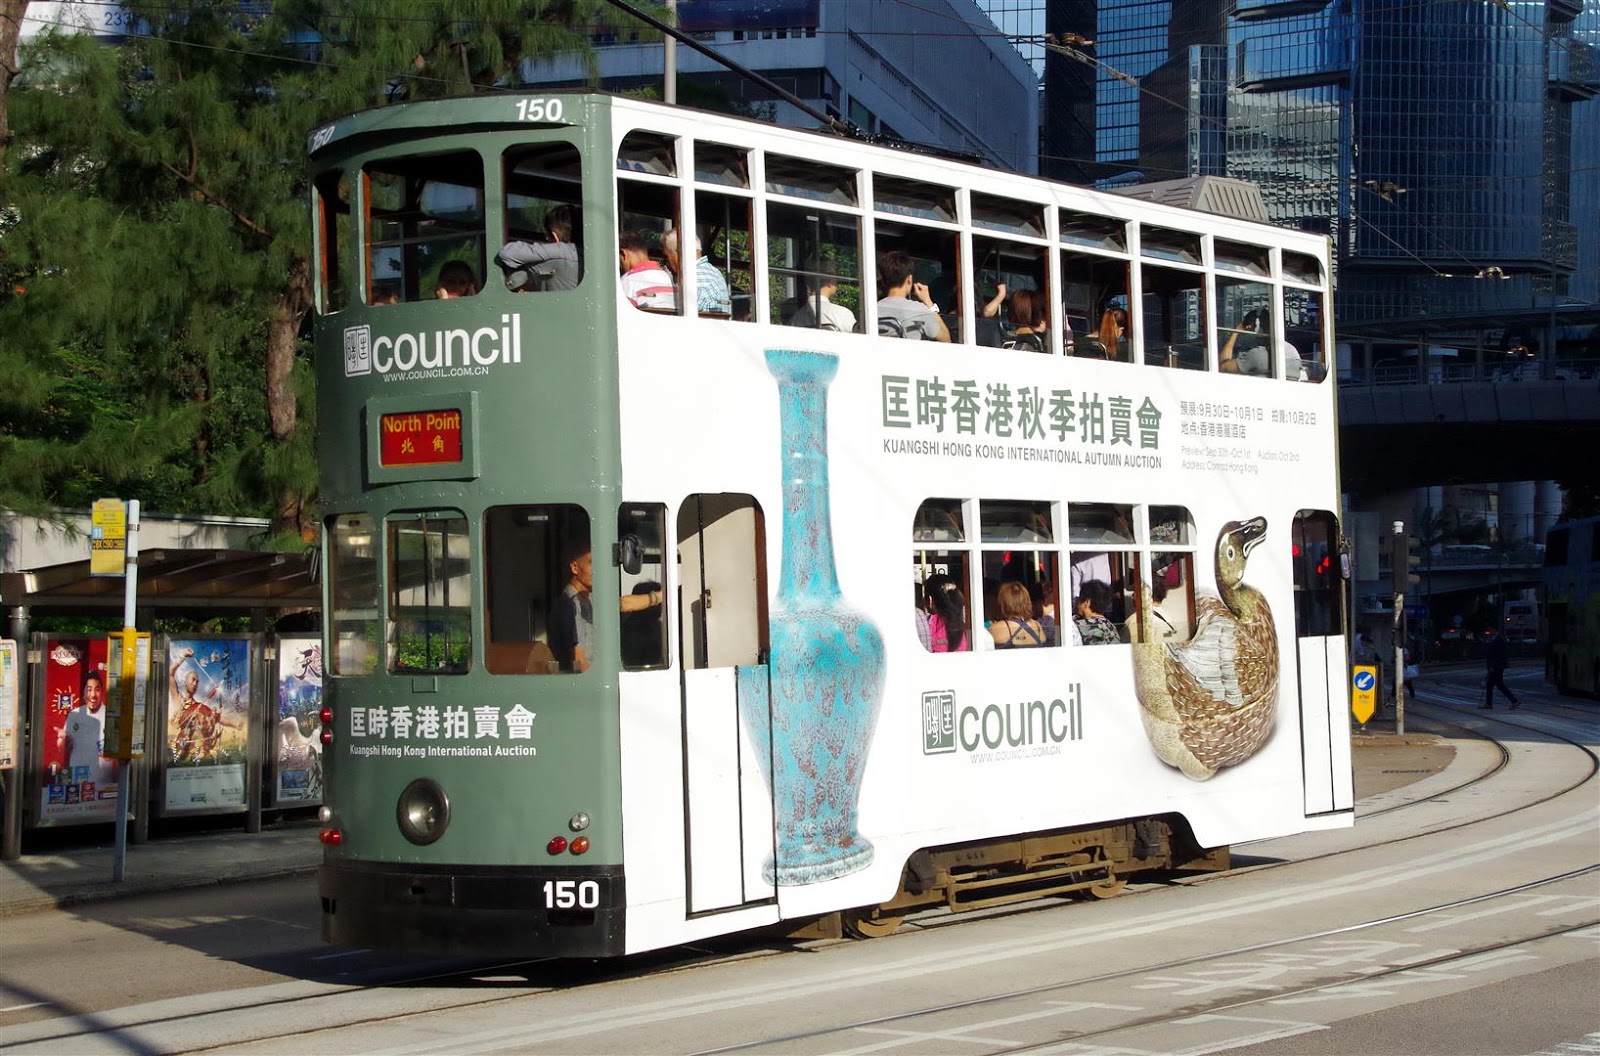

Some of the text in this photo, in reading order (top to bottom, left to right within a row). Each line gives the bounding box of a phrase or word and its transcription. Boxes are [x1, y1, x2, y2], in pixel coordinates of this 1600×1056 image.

[515, 99, 563, 121] 150
[372, 313, 521, 373] council
[383, 367, 489, 382] WWW.COUNCIL.COM.CN
[383, 413, 461, 433] North Point
[881, 374, 1163, 450] 匡時香港秋季拍賣會
[883, 438, 1162, 469] KUANGSHI HONG KONG INTERNATIONAL AUTUMN AUCTION
[350, 704, 536, 739] 匡時香港拍賣會
[959, 683, 1082, 752] council
[350, 744, 536, 758] Kuangshi Hong Kong International Auction
[543, 880, 600, 909] 150
